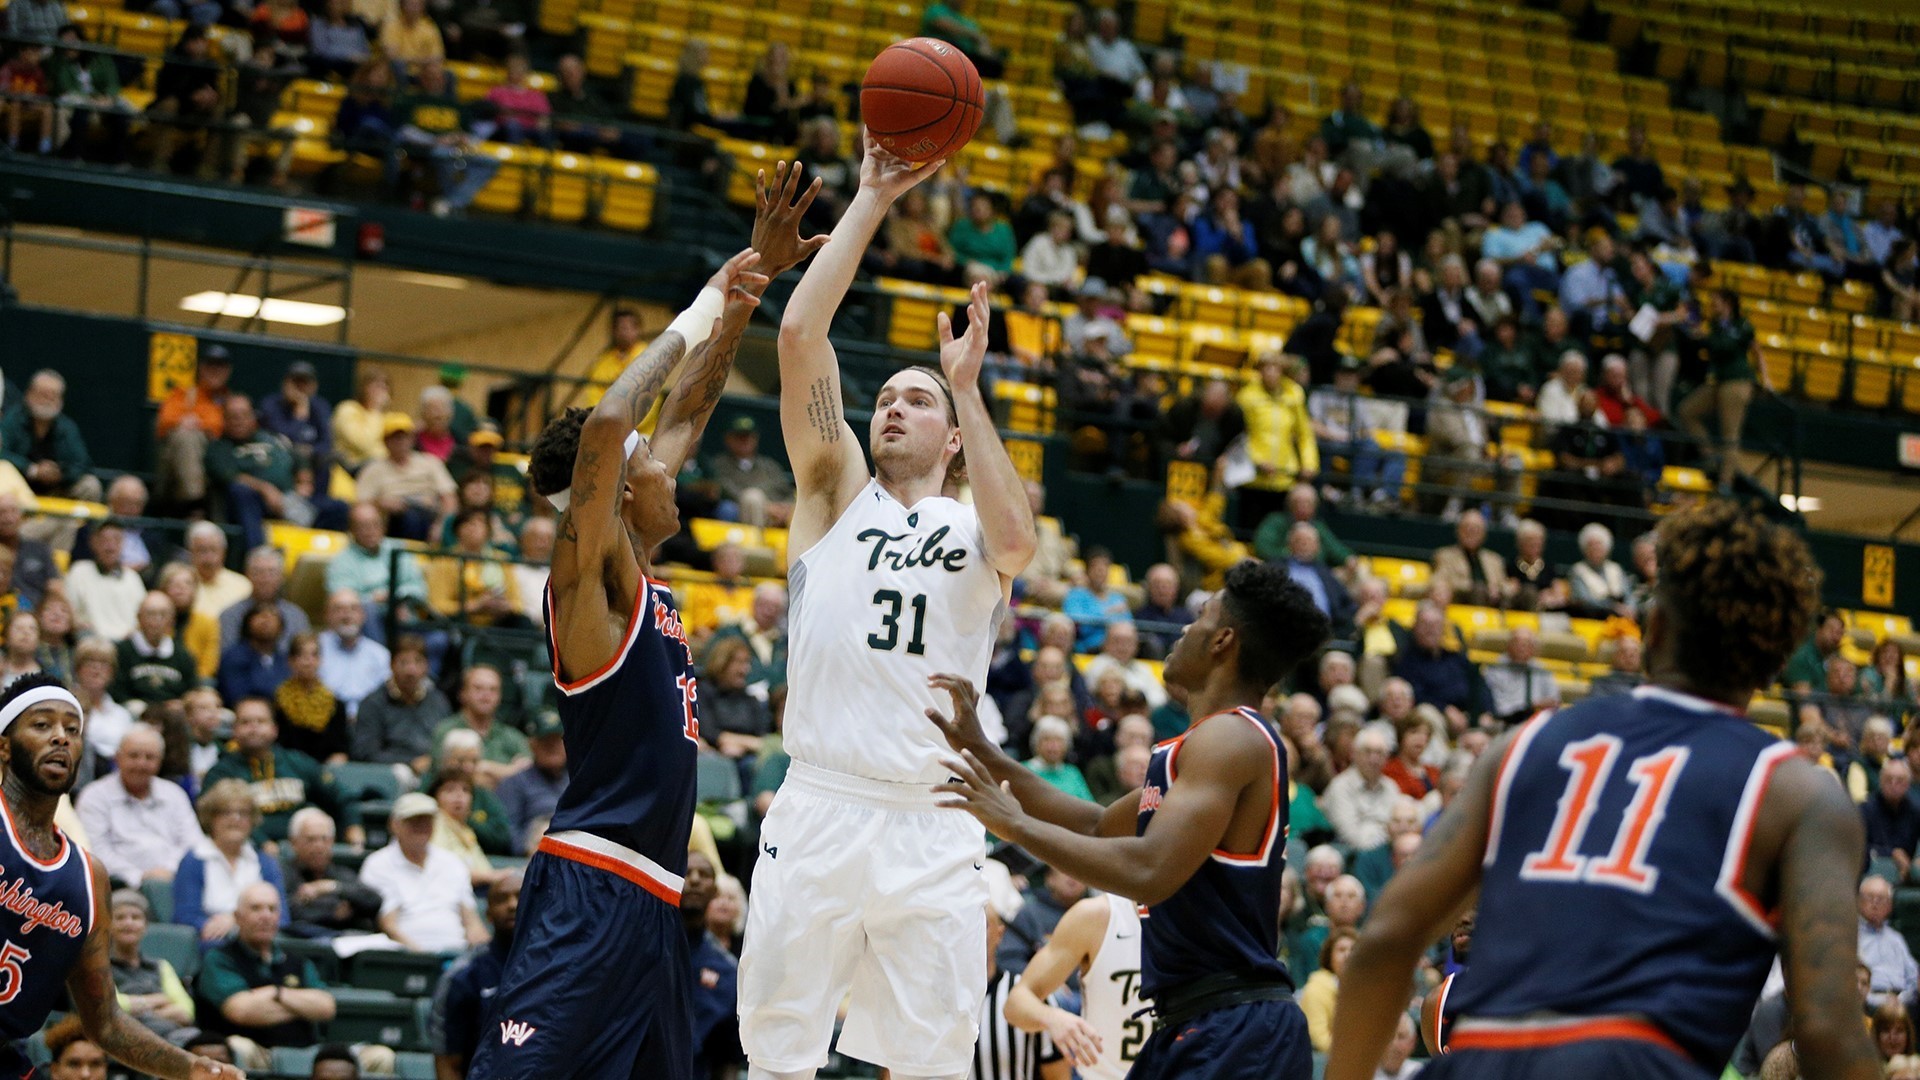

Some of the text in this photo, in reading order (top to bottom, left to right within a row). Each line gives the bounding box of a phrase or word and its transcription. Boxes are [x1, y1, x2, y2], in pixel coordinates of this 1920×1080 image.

[857, 525, 968, 572] Tribe
[867, 588, 928, 656] 31
[1519, 732, 1691, 895] 11
[0, 866, 82, 938] shington
